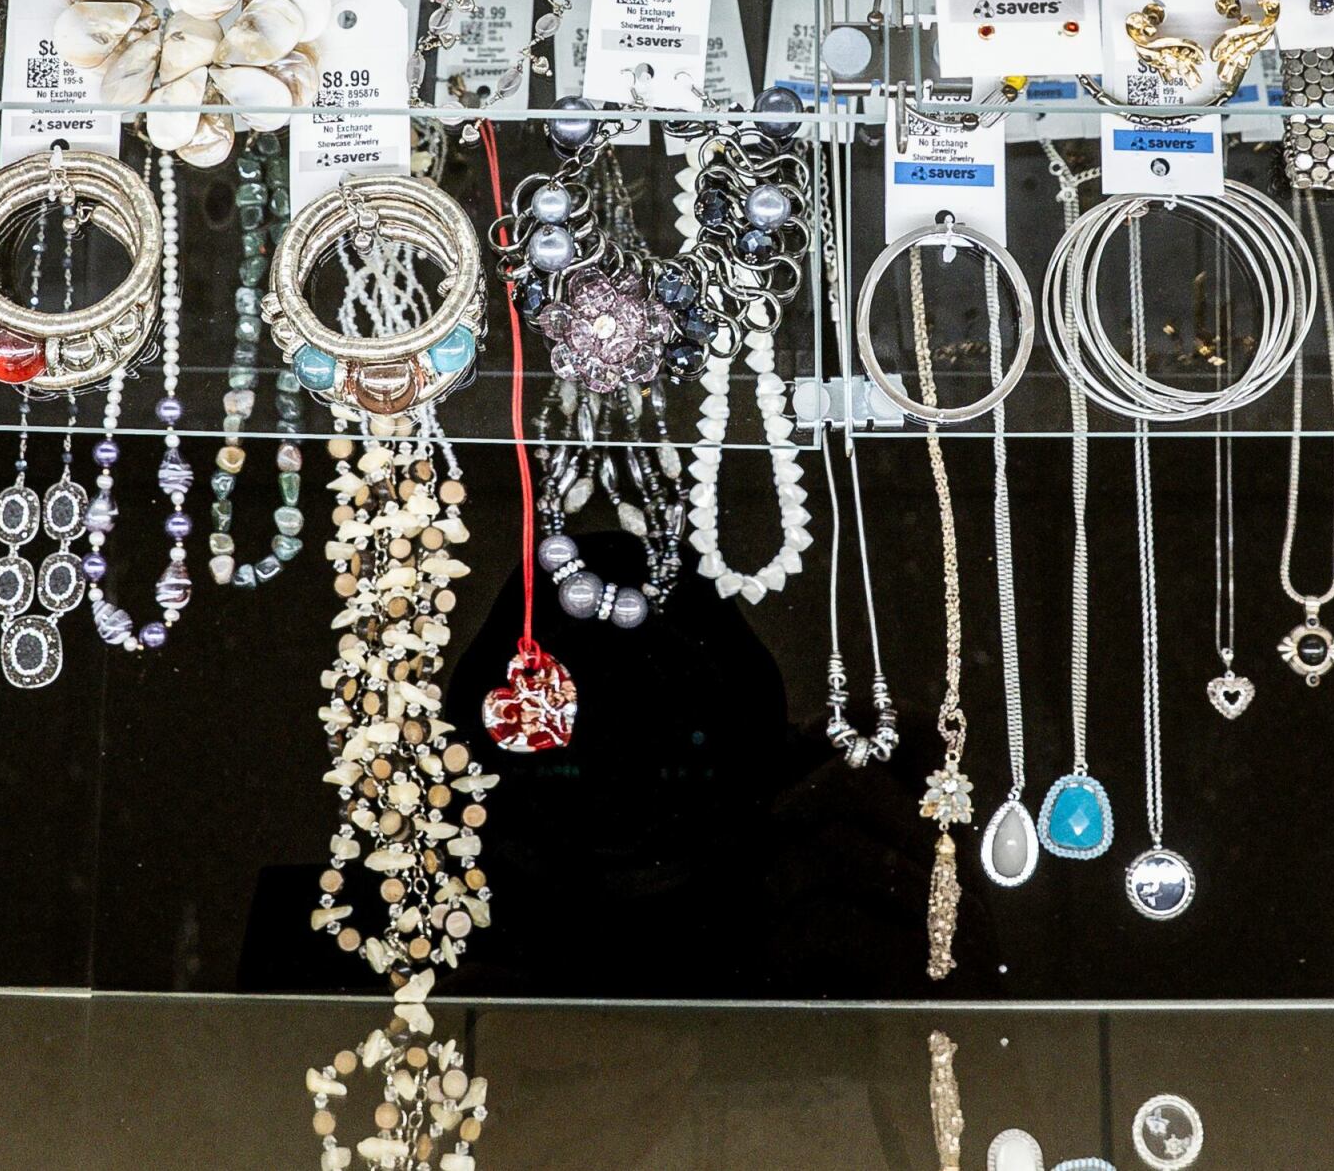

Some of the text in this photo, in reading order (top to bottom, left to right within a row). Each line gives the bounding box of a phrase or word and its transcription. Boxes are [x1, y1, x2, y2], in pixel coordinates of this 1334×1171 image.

[995, 0, 1061, 14] savers
[636, 36, 681, 48] savers
[322, 69, 369, 89] $8.99
[46, 119, 93, 129] savers
[918, 137, 968, 149] No Exchange
[1147, 138, 1196, 149] savers
[333, 151, 379, 163] savers
[928, 168, 977, 179] savers
